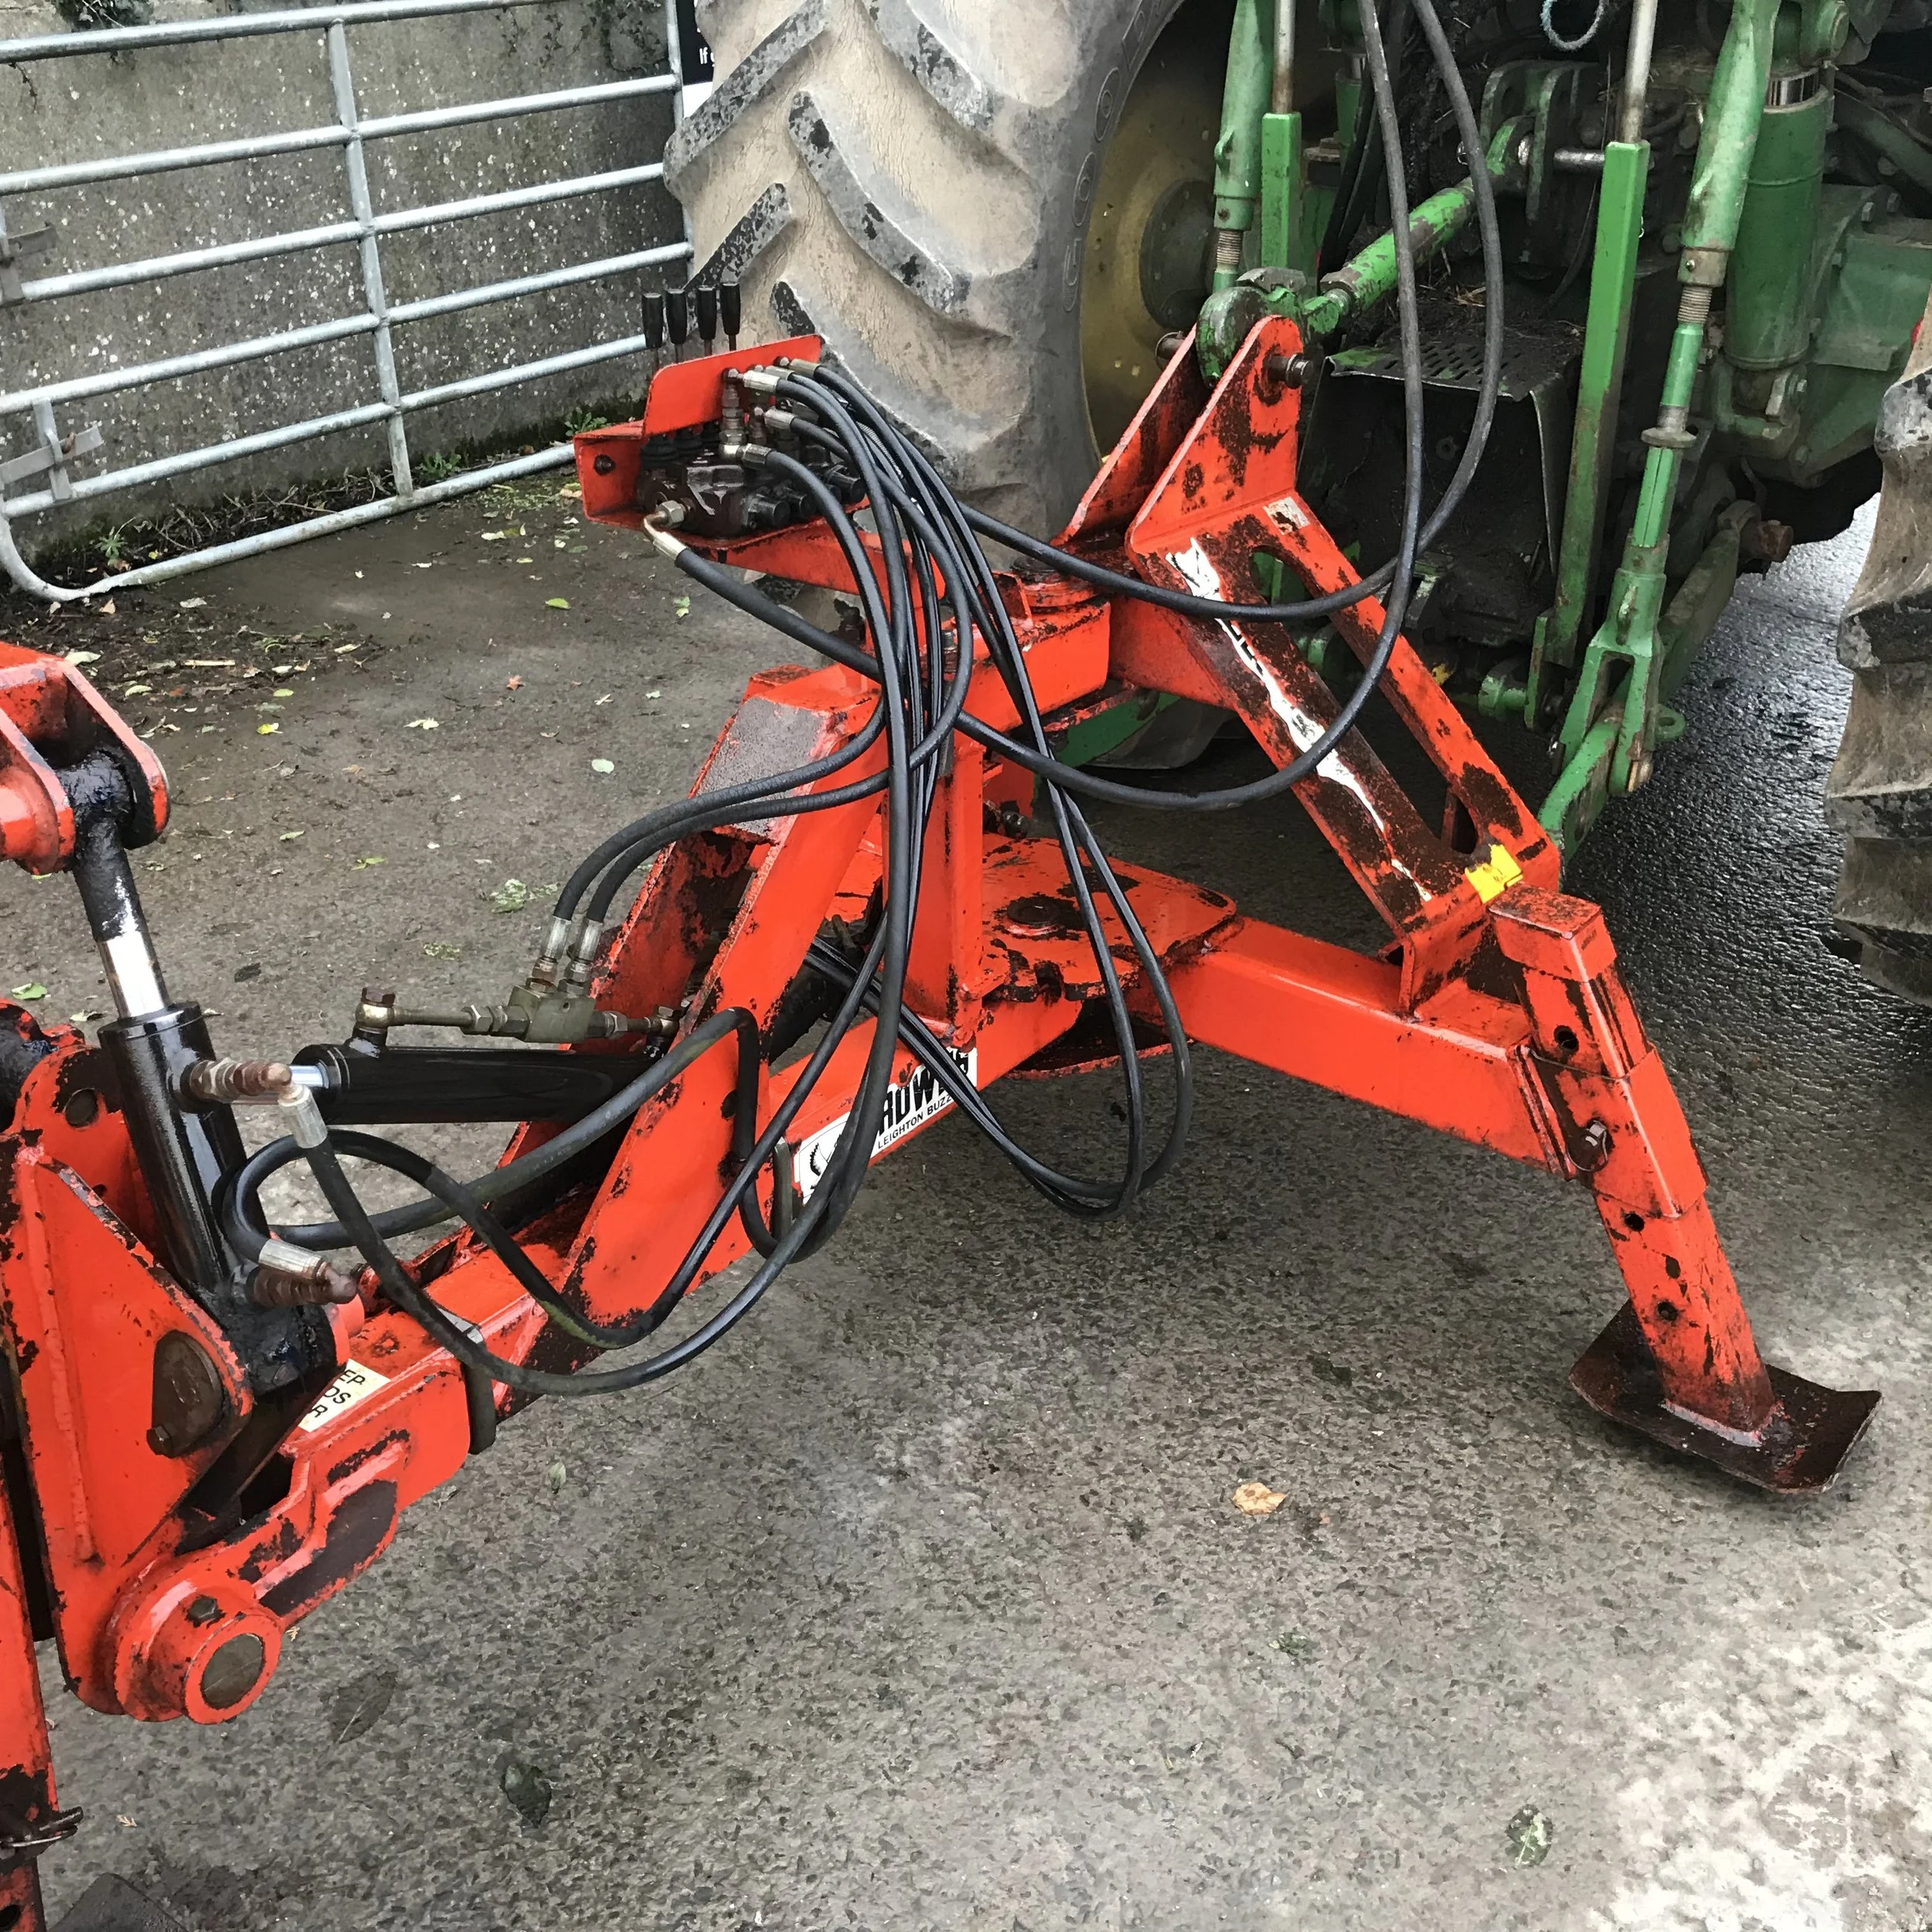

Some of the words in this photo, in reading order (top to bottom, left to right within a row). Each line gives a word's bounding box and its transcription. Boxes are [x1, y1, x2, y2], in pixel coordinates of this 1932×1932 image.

[878, 1111, 923, 1149] LEIGHTON
[927, 1094, 952, 1116] BUZZ
[338, 1369, 366, 1385] EP
